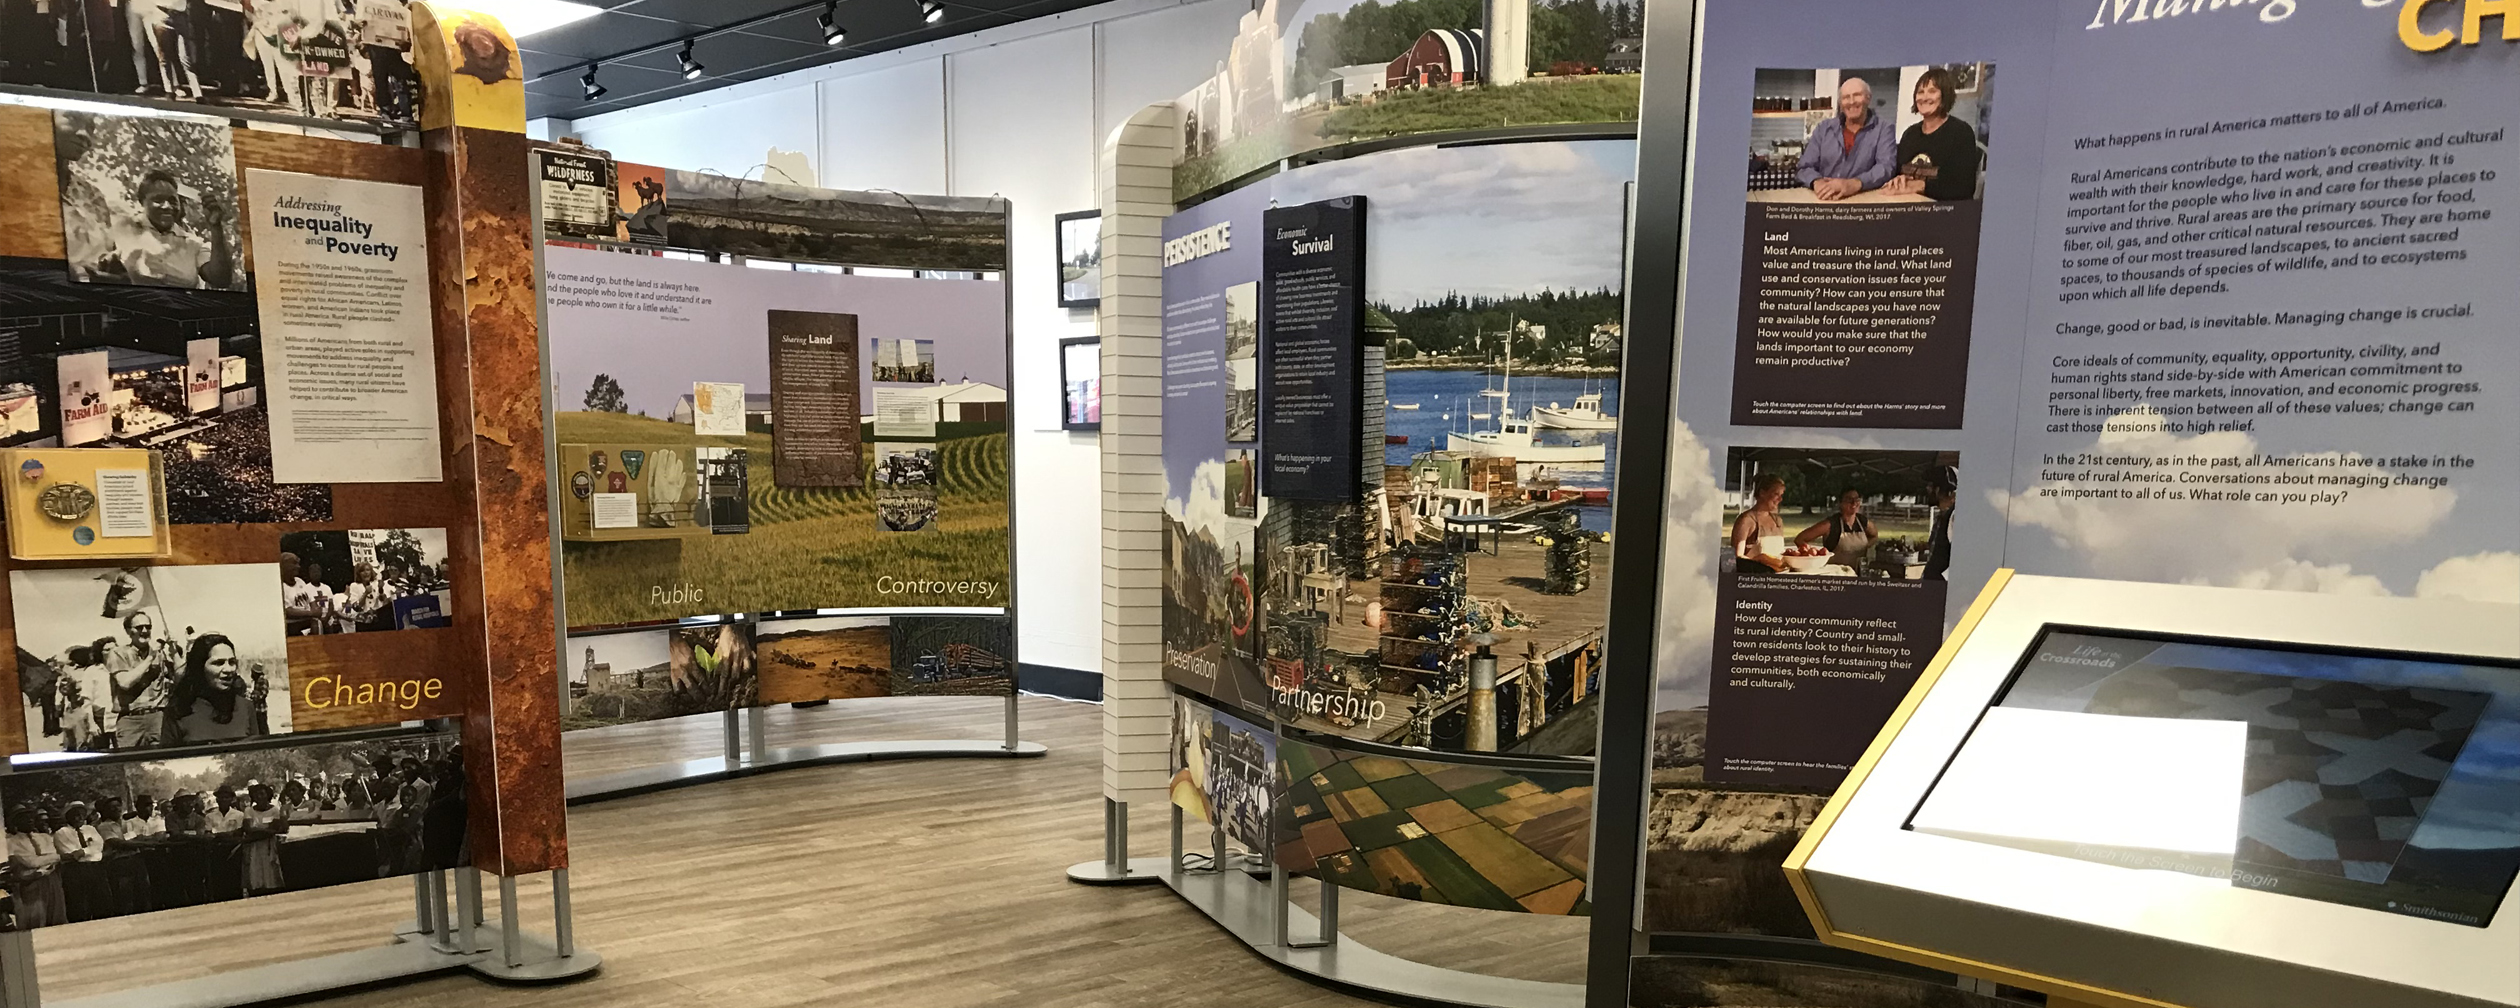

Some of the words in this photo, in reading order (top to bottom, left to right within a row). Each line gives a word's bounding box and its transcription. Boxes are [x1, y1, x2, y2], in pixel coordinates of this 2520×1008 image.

[365, 6, 405, 21] CARAVAN
[302, 60, 330, 72] LAND
[2074, 136, 2106, 150] What
[2108, 131, 2161, 148] happens
[2164, 127, 2175, 139] in
[2179, 121, 2208, 137] rural
[2211, 118, 2266, 134] America
[2269, 112, 2321, 126] matters
[2325, 109, 2339, 120] to
[2343, 103, 2360, 118] all
[2363, 101, 2379, 116] of
[2381, 98, 2446, 113] America.
[273, 195, 342, 216] Addressing
[273, 212, 373, 239] Inequality
[1276, 225, 1308, 240] Economic
[1164, 221, 1231, 268] PERSISTENCE
[1291, 233, 1334, 256] Survival
[1764, 231, 1788, 241] Land
[305, 235, 323, 246] and
[325, 237, 399, 261] Poverty
[1763, 245, 1788, 255] Most
[1789, 246, 1842, 256] Americans
[1844, 245, 1872, 258] living
[1874, 248, 1883, 256] in
[1886, 245, 1909, 256] rural
[1911, 245, 1944, 258] places
[557, 273, 578, 282] come
[579, 274, 594, 283] and
[595, 276, 607, 286] go,
[608, 275, 621, 285] but
[622, 277, 634, 287] the
[635, 278, 652, 288] land
[659, 280, 682, 293] always
[2059, 292, 2088, 304] upon
[2092, 285, 2126, 300] which
[2129, 284, 2144, 298] all
[2147, 283, 2166, 296] life
[2169, 279, 2229, 297] depends.
[547, 283, 557, 292] nd
[559, 283, 571, 293] the
[572, 286, 599, 296] people
[600, 287, 616, 297] who
[617, 288, 633, 298] love
[634, 291, 640, 299] it
[640, 291, 654, 300] and
[655, 292, 694, 304] understand
[556, 297, 583, 308] people
[584, 298, 600, 308] who
[601, 301, 617, 309] own
[618, 302, 624, 310] it
[625, 301, 635, 310] for
[642, 302, 658, 312] little
[2055, 322, 2103, 337] Change,
[2107, 318, 2139, 335] good
[2142, 321, 2156, 331] or
[2159, 317, 2186, 330] bad,
[2190, 317, 2199, 329] is
[2203, 312, 2270, 328] inevitable.
[2274, 311, 2345, 326] Managing
[2348, 307, 2402, 323] change
[2406, 309, 2417, 319] is
[2421, 302, 2473, 318] crucial.
[782, 335, 807, 346] Sharing
[808, 334, 833, 345] Land
[1755, 355, 1788, 365] remain
[1791, 355, 1850, 367] productive?
[190, 383, 208, 394] FARM
[208, 379, 219, 389] AID
[64, 408, 91, 422] FARM
[92, 402, 108, 417] AID
[1290, 453, 1315, 464] happening
[1321, 456, 1332, 464] your
[1274, 464, 1286, 472] local
[1285, 464, 1310, 475] economy?
[2039, 488, 2058, 497] are
[2061, 486, 2118, 500] important
[2120, 488, 2133, 499] to
[2135, 486, 2150, 499] all
[2153, 487, 2166, 499] of
[2169, 491, 2185, 500] us.
[2189, 488, 2223, 501] What
[2226, 488, 2251, 501] role
[2254, 492, 2277, 502] can
[2282, 493, 2306, 505] you
[2310, 489, 2348, 506] play?
[651, 583, 703, 606] Public
[876, 575, 999, 599] Controversy
[1735, 599, 1772, 612] Identity
[1734, 612, 1757, 622] How
[1758, 613, 1782, 623] does
[1784, 616, 1807, 626] your
[1808, 617, 1863, 629] community
[1865, 617, 1896, 628] reflect
[1166, 640, 1218, 682] Preservation
[2040, 652, 2116, 668] Crossroads
[2073, 645, 2102, 657] Life
[304, 676, 443, 710] Change
[1729, 677, 1748, 686] and
[1750, 677, 1795, 690] culturally.
[1272, 675, 1386, 729] Partnership
[2074, 843, 2117, 860] Touch
[2121, 852, 2144, 865] the
[2149, 855, 2205, 875] Screen
[2210, 866, 2226, 878] to
[2231, 868, 2279, 887] Begin
[2401, 902, 2479, 924] Smithsonian
